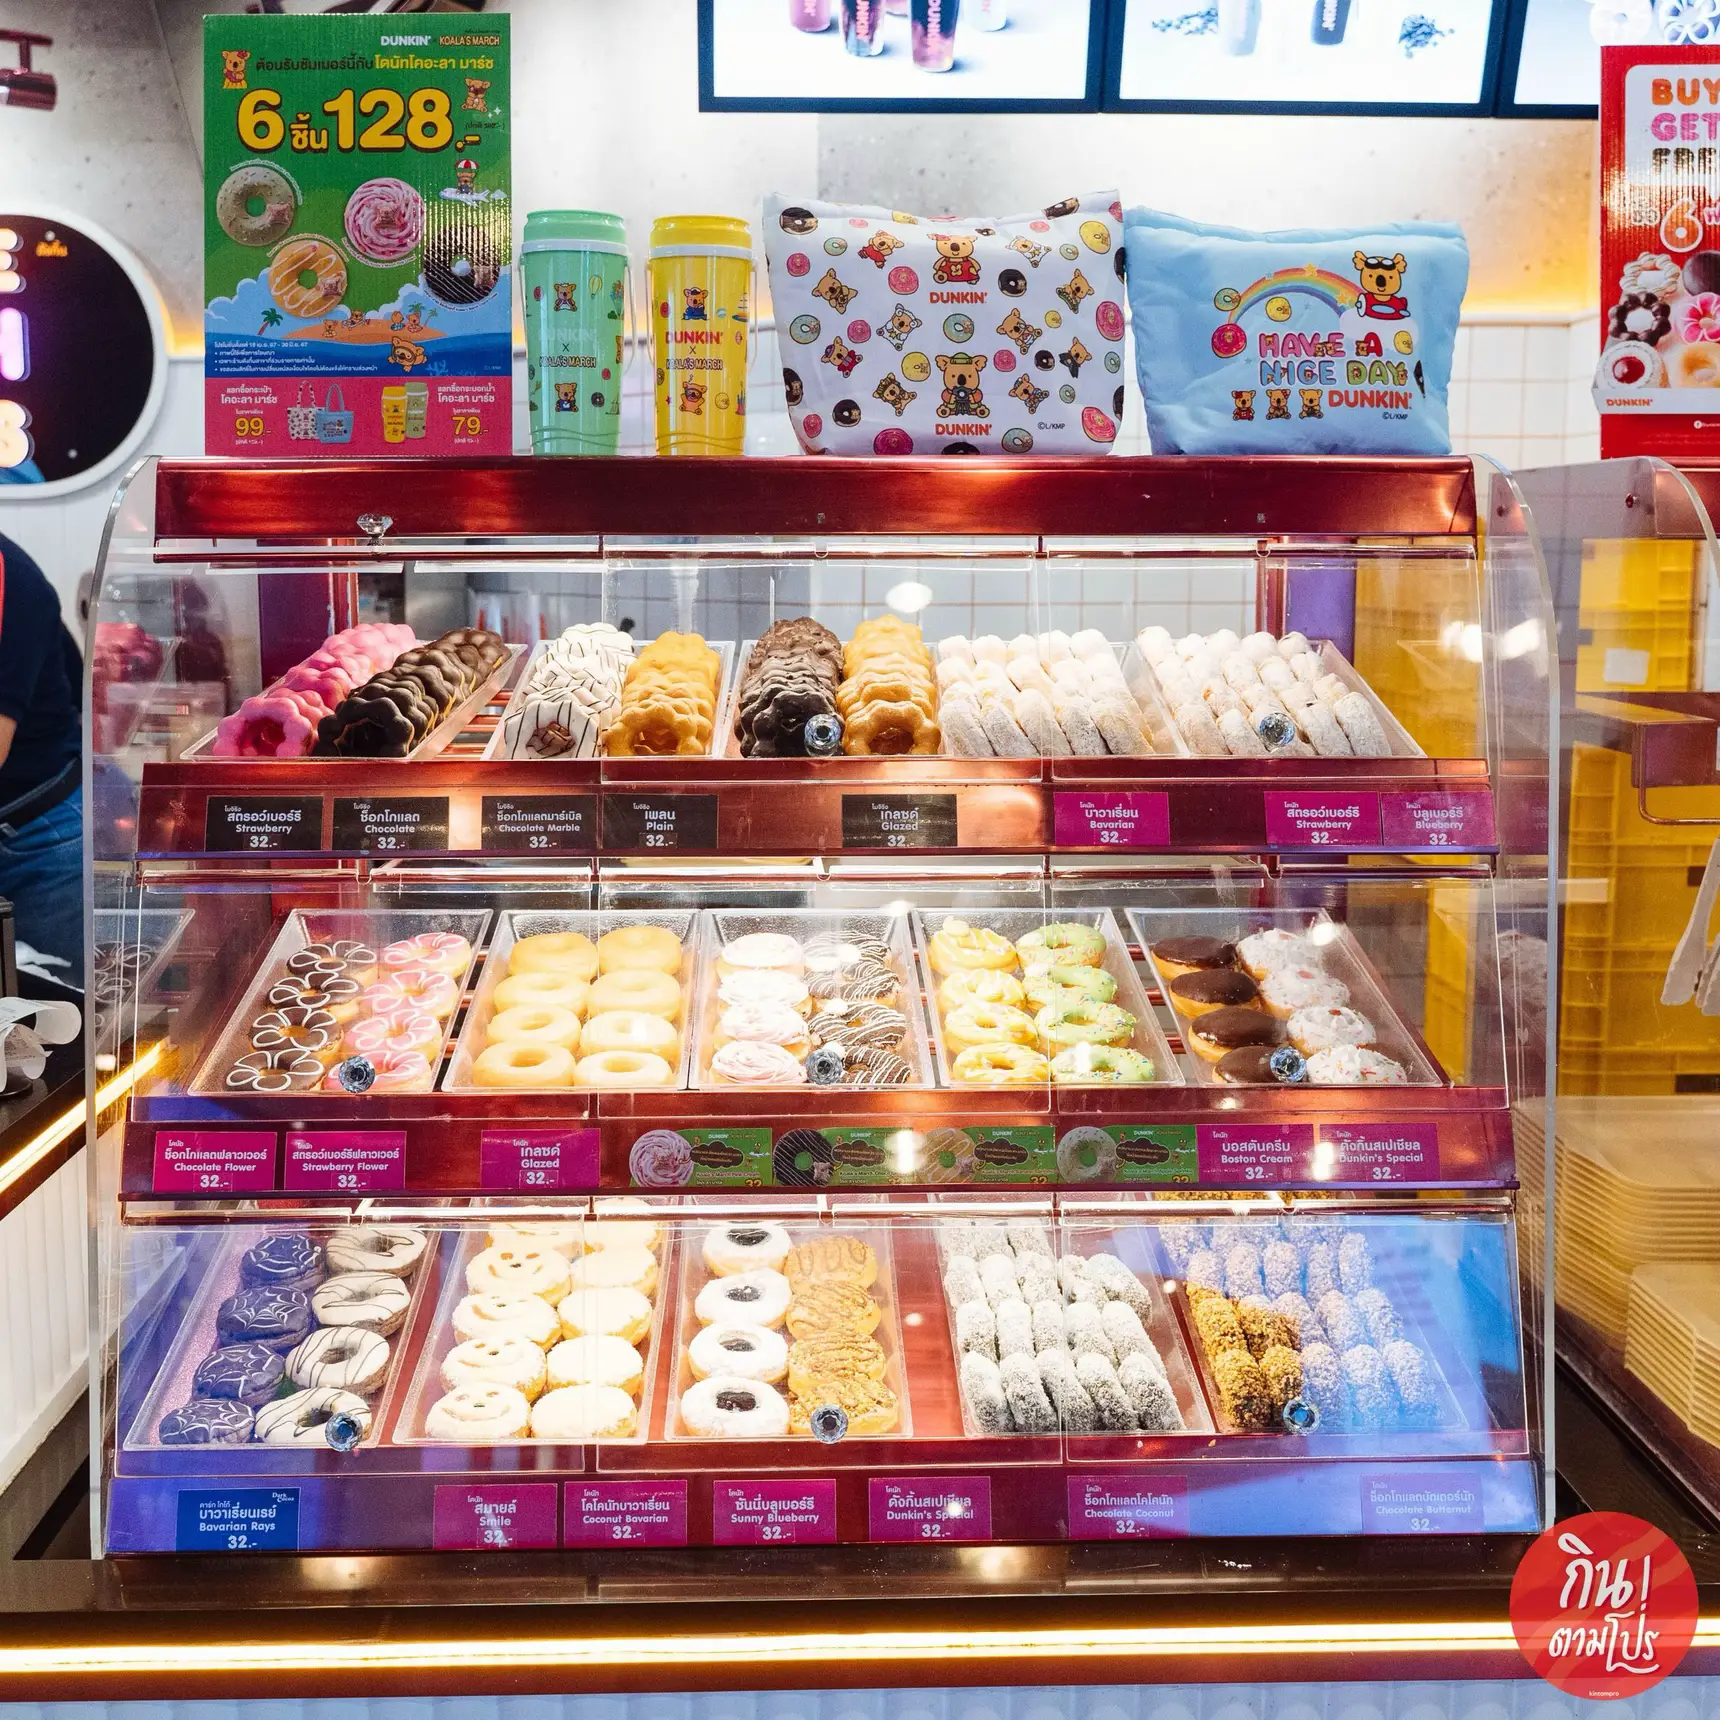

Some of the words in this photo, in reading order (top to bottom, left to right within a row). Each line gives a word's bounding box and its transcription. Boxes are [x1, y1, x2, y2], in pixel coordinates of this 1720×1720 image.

[381, 35, 432, 46] DUNKIN'
[439, 35, 471, 46] KOALA'S
[472, 35, 500, 46] MARCH
[1651, 78, 1720, 106] BUY
[238, 88, 285, 152] 6
[290, 112, 328, 152] ชิ้น
[1651, 112, 1720, 141] GET
[568, 356, 597, 368] MARCH
[695, 358, 724, 370] MARCH
[1259, 360, 1337, 386] NICE
[235, 823, 293, 835] Strawberry
[364, 824, 416, 833] Chocolate
[499, 823, 545, 832] Chocolate
[547, 823, 580, 832] Marble
[646, 821, 674, 831] Plain
[881, 821, 919, 831] Glazed
[1089, 820, 1135, 829] Bavarian
[1296, 820, 1352, 830] Strawberry
[1415, 820, 1464, 830] Blueberry
[520, 1158, 560, 1168] Glazed
[1221, 1155, 1257, 1163] Boston
[1259, 1155, 1293, 1163] Cream
[1386, 1152, 1423, 1164] Special
[174, 1162, 221, 1171] Chocolate
[224, 1162, 256, 1171] Flower
[302, 1162, 354, 1173] Strawberry
[357, 1162, 389, 1170] Flower
[1084, 1509, 1132, 1518] Chocolate
[1135, 1509, 1175, 1518] Coconut
[1375, 1505, 1424, 1514] Chocolate
[1426, 1505, 1471, 1514] Butternut
[582, 1514, 622, 1524] Coconut
[625, 1513, 668, 1523] Bavarian
[731, 1513, 764, 1525] Sunny
[767, 1512, 819, 1524] Blueberry
[886, 1510, 932, 1520] Dunkin's
[479, 1516, 511, 1526] Smile
[199, 1521, 247, 1532] Bavarian
[251, 1521, 276, 1532] Rays
